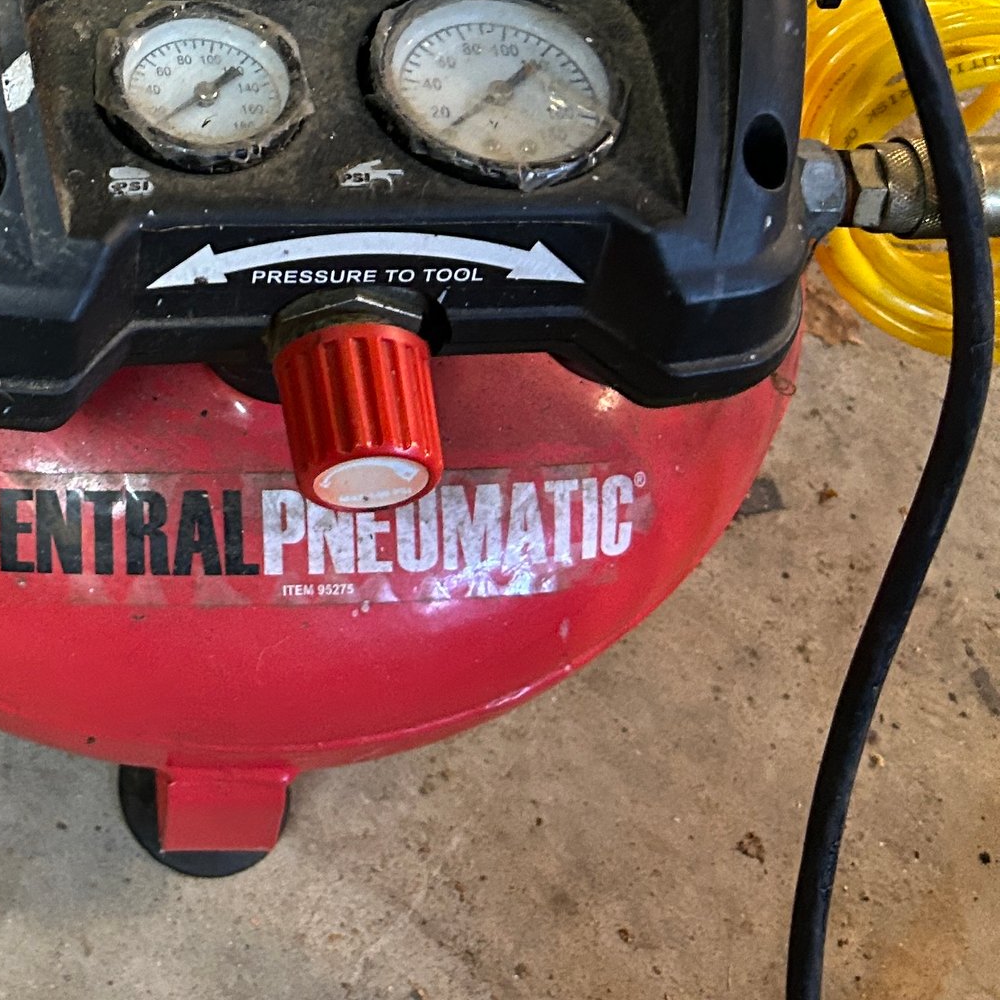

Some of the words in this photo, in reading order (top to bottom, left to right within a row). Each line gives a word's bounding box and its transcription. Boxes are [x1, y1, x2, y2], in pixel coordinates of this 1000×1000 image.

[492, 44, 519, 57] 100
[176, 55, 192, 65] 80
[200, 55, 222, 65] 100
[156, 66, 171, 76] 60
[431, 105, 450, 119] 20
[251, 269, 376, 284] PRESSURE
[385, 269, 415, 283] TO
[425, 267, 484, 283] TOOL
[282, 584, 314, 596] ITEM
[317, 583, 355, 595] 95275
